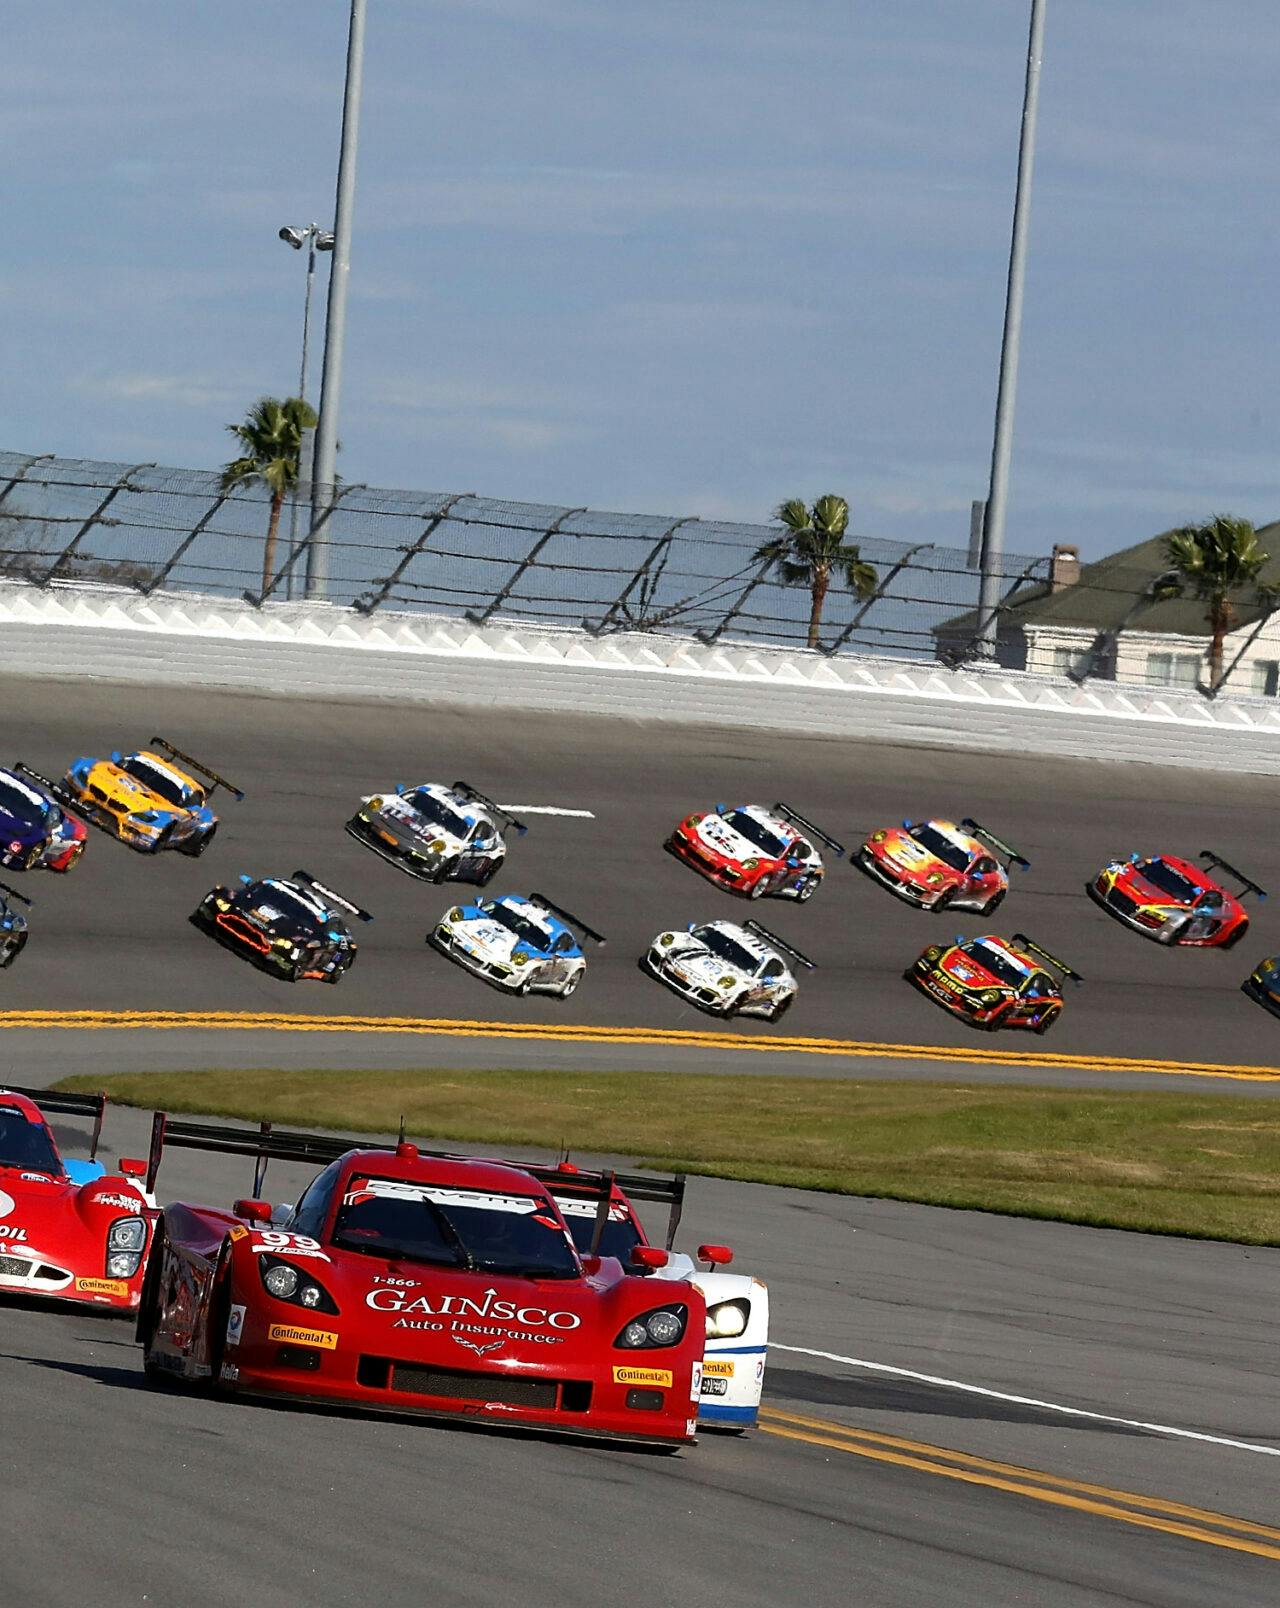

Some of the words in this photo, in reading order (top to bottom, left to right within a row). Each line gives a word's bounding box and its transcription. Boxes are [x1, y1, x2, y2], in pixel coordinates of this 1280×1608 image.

[369, 1183, 536, 1207] CORVETTE
[261, 1232, 321, 1251] 99
[372, 1276, 422, 1288] 1-866-
[365, 1288, 581, 1330] GAINSCO
[271, 1326, 324, 1343] Continental
[392, 1317, 444, 1332] Auto
[450, 1320, 557, 1345] Insurance
[616, 1368, 664, 1382] Continental
[703, 1363, 726, 1373] nental
